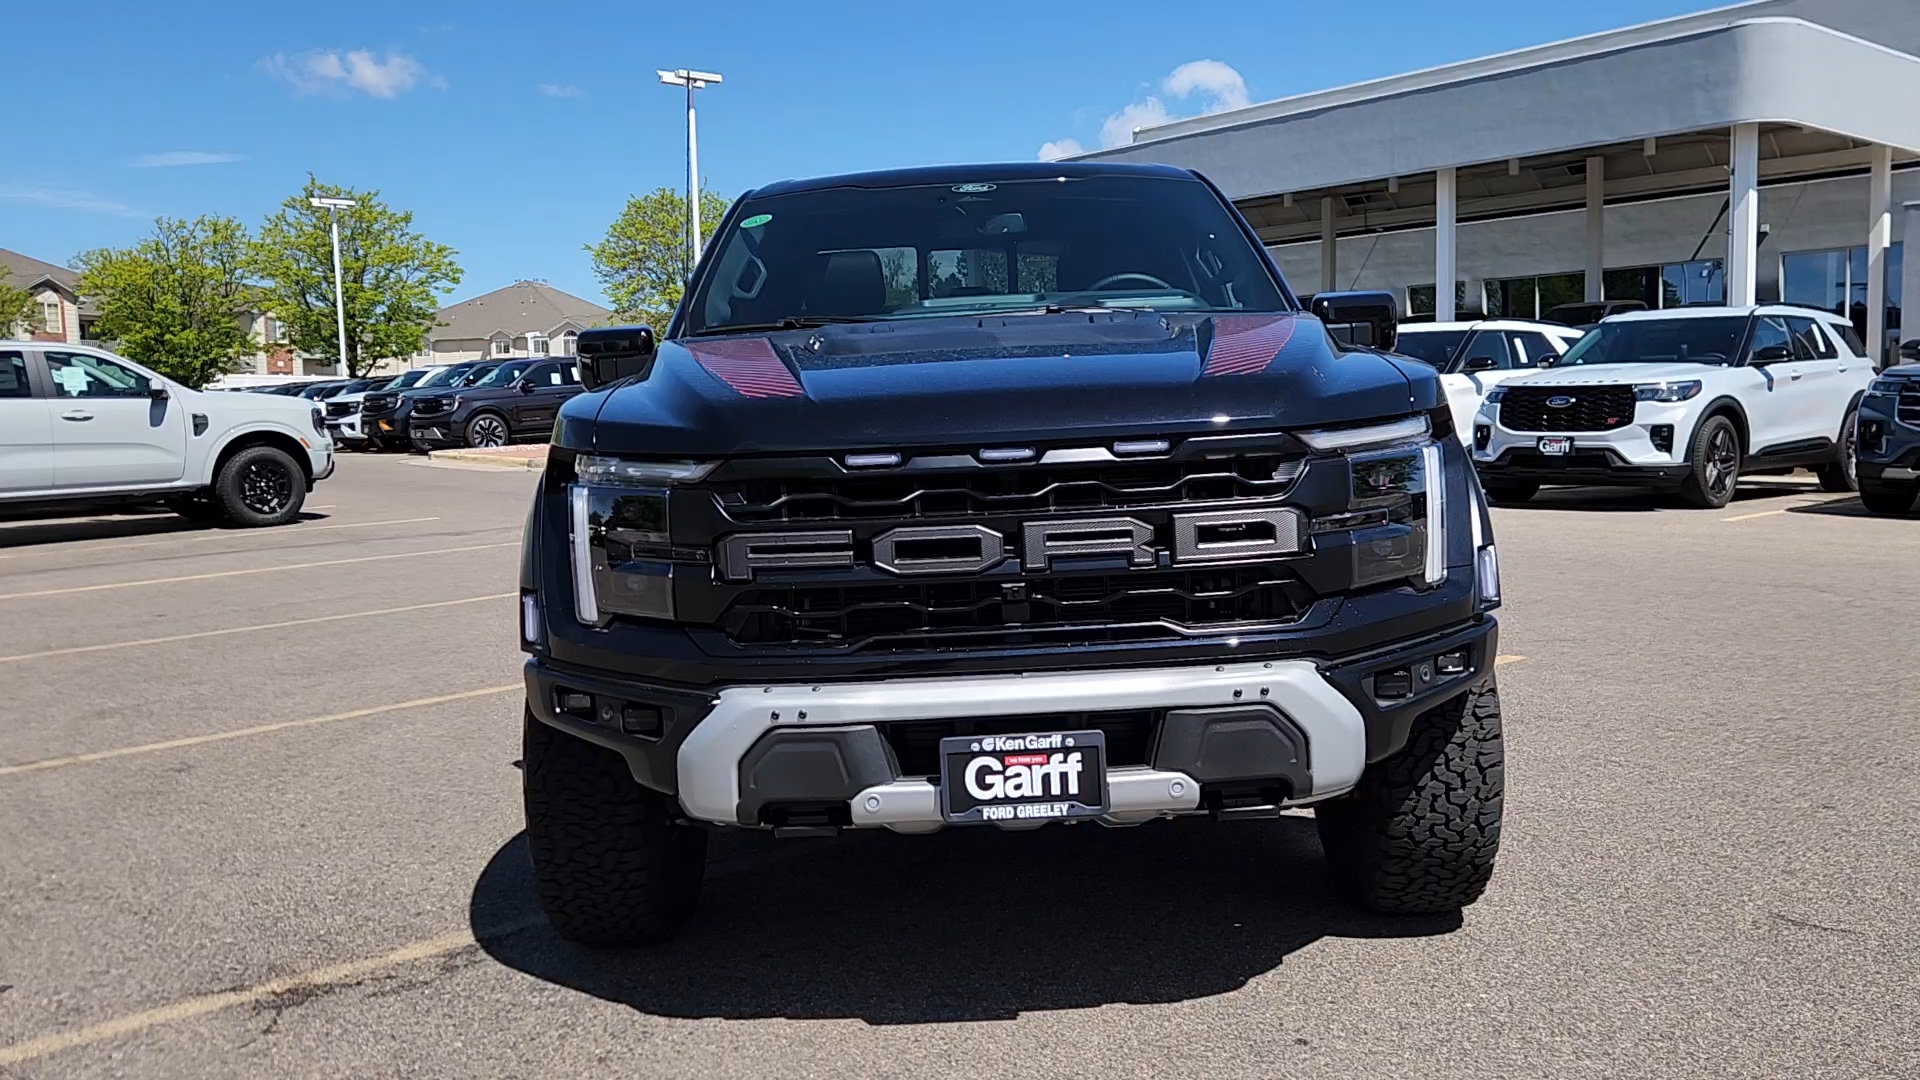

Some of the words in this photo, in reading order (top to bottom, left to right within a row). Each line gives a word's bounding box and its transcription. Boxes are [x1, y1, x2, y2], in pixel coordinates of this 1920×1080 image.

[715, 506, 1303, 581] FORD
[995, 736, 1025, 750] Ken
[1025, 734, 1063, 749] Garff
[964, 752, 1083, 800] Garff
[983, 805, 1015, 820] FORD
[1016, 803, 1069, 818] GREELEY
